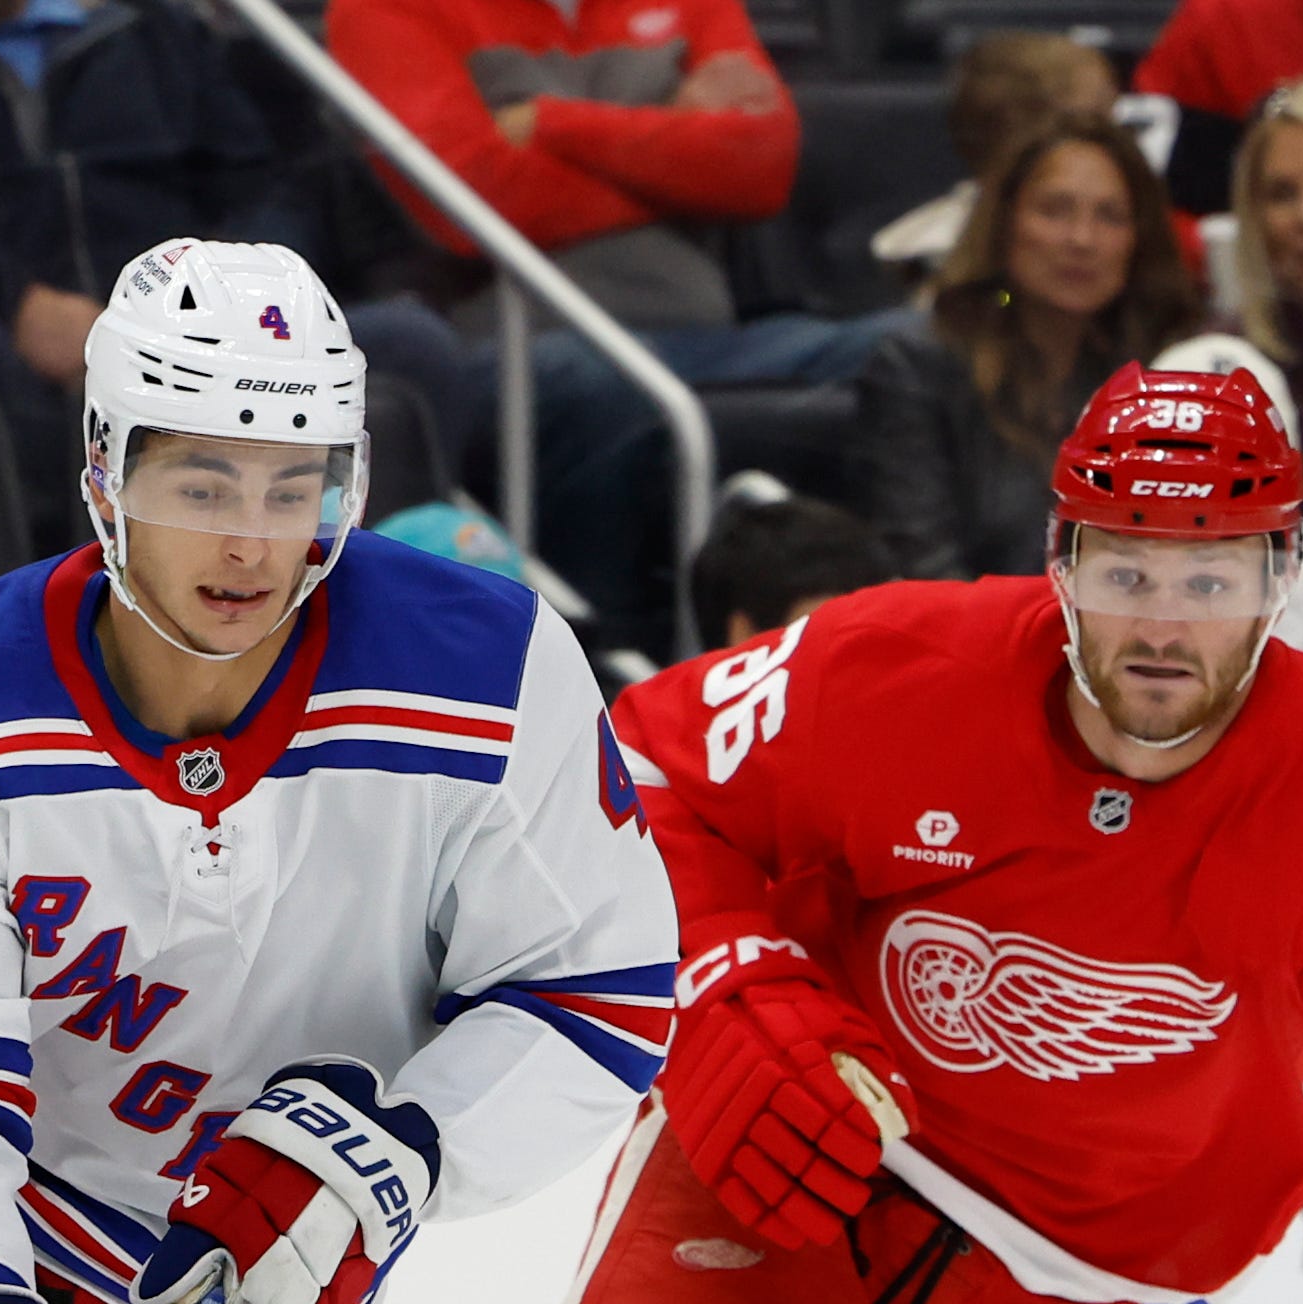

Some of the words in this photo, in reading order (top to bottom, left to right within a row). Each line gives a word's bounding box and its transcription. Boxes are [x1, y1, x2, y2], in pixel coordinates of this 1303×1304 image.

[129, 269, 156, 297] Moore
[140, 253, 173, 288] Benjamin
[259, 305, 291, 340] 4
[1146, 399, 1207, 432] 36
[1129, 479, 1214, 498] CCM
[188, 759, 213, 788] NHL
[929, 818, 949, 839] P
[892, 844, 976, 871] PRIORITY
